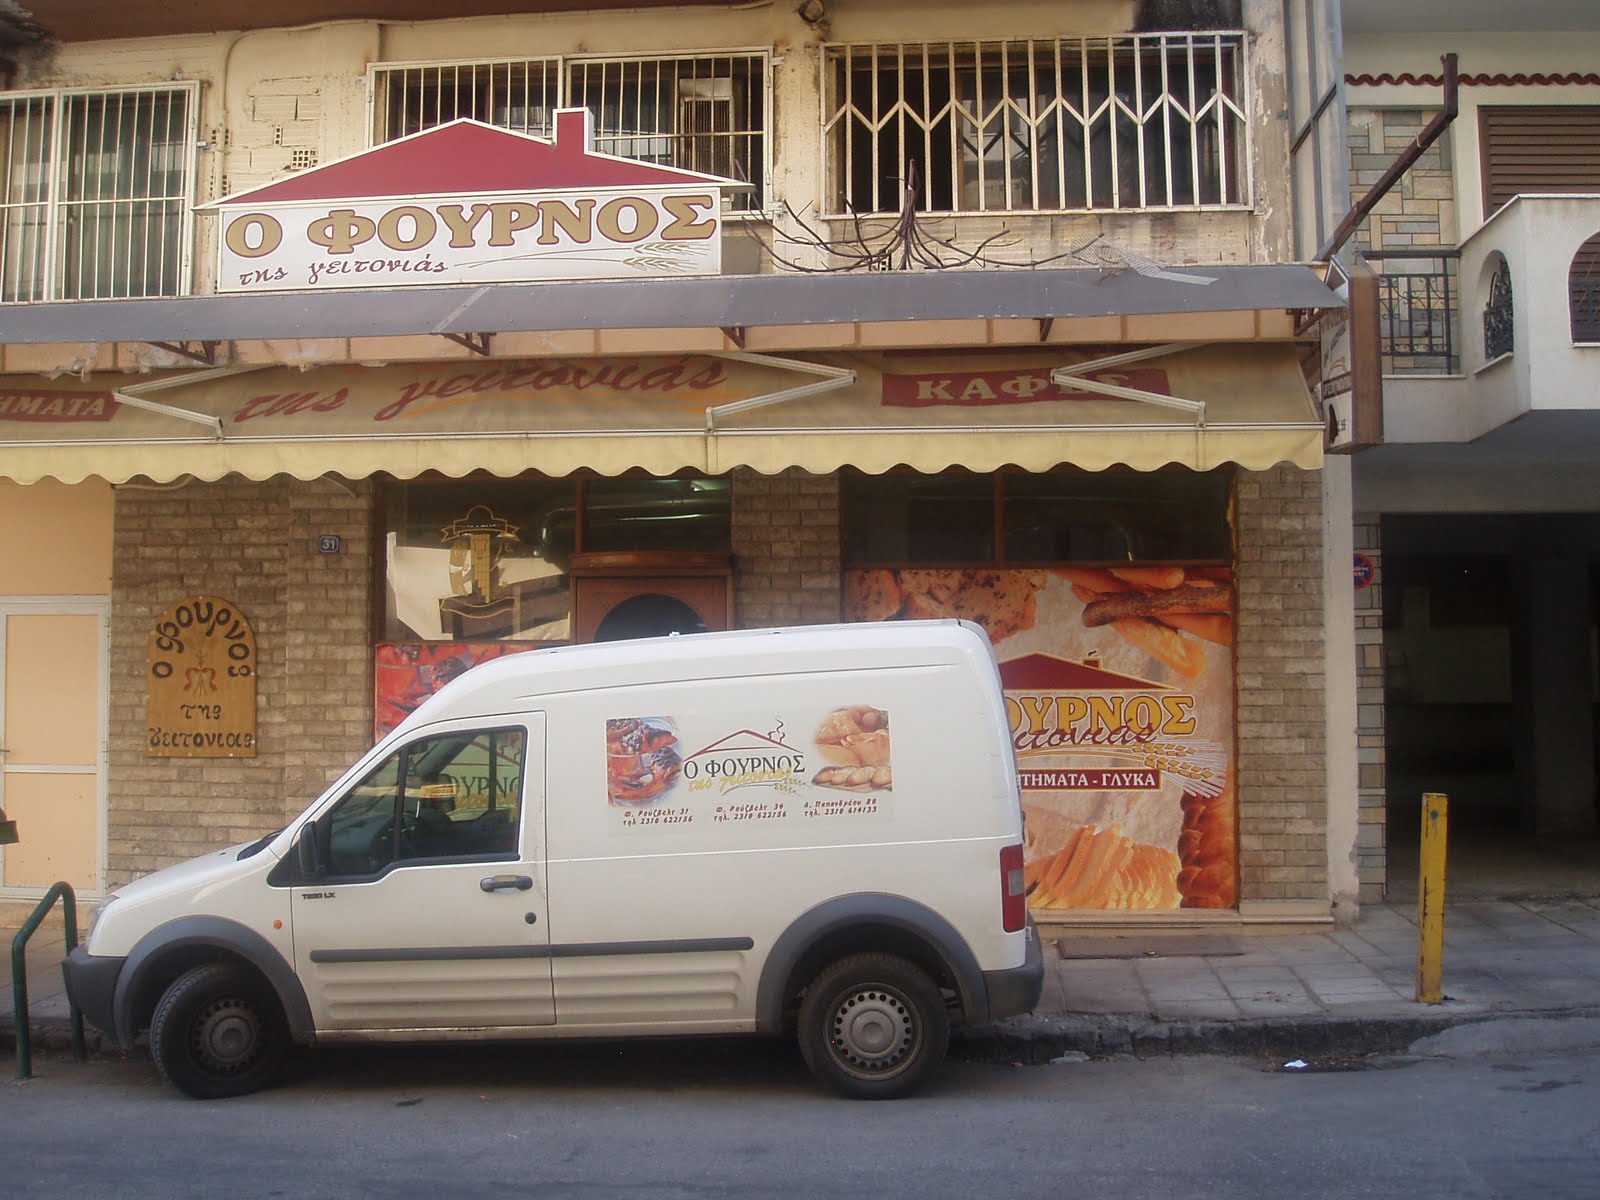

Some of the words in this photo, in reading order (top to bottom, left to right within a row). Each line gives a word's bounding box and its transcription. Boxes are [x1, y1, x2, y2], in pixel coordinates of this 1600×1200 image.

[225, 213, 283, 258] Ο
[307, 195, 717, 255] ΦΟΥΡΝΟΣ
[308, 253, 449, 286] γειτονιάς
[916, 373, 1136, 400] ΚΑΦΣ
[322, 539, 336, 550] 31
[684, 760, 699, 779] Ο
[705, 755, 805, 777] ΦΟΥΡΝΟΣ
[1018, 774, 1089, 787] ΤΗΜΑΤΑ
[1101, 773, 1156, 786] ΓΛΥΚΑ
[734, 812, 753, 820] 2310
[757, 810, 787, 819] 622156
[824, 808, 844, 816] 2310
[663, 815, 693, 824] 622156
